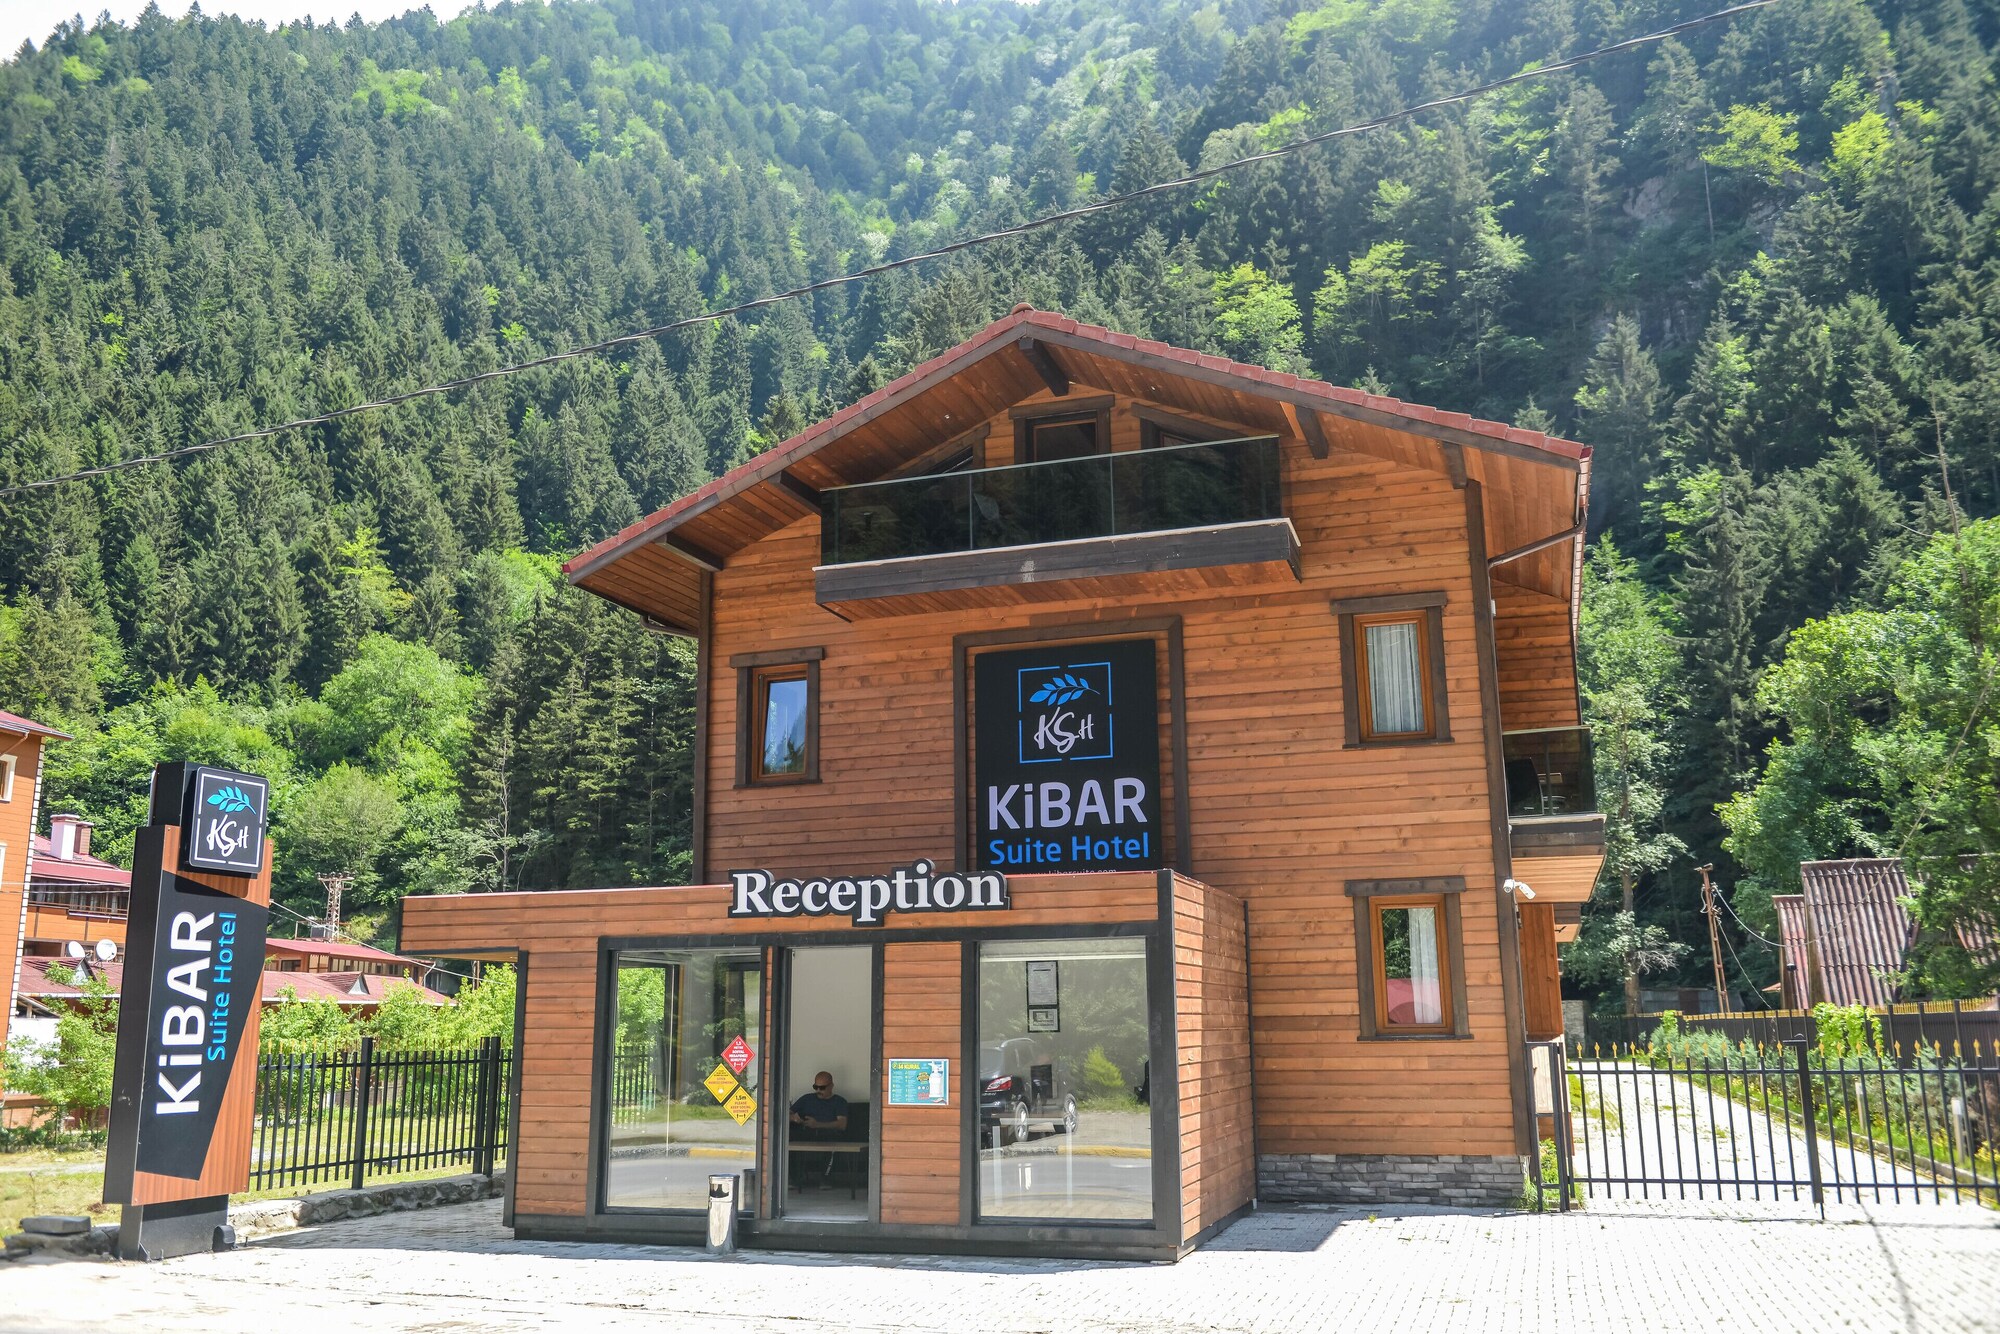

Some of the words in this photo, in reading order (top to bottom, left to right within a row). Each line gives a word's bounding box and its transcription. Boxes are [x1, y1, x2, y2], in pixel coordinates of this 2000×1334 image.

[988, 777, 1148, 831] KiBAR
[989, 837, 1062, 865] Suite
[1071, 832, 1149, 861] Hotel
[731, 862, 1005, 923] Reception
[214, 912, 237, 984] Hotel
[155, 910, 215, 1115] KiBAR
[207, 991, 231, 1062] Suite
